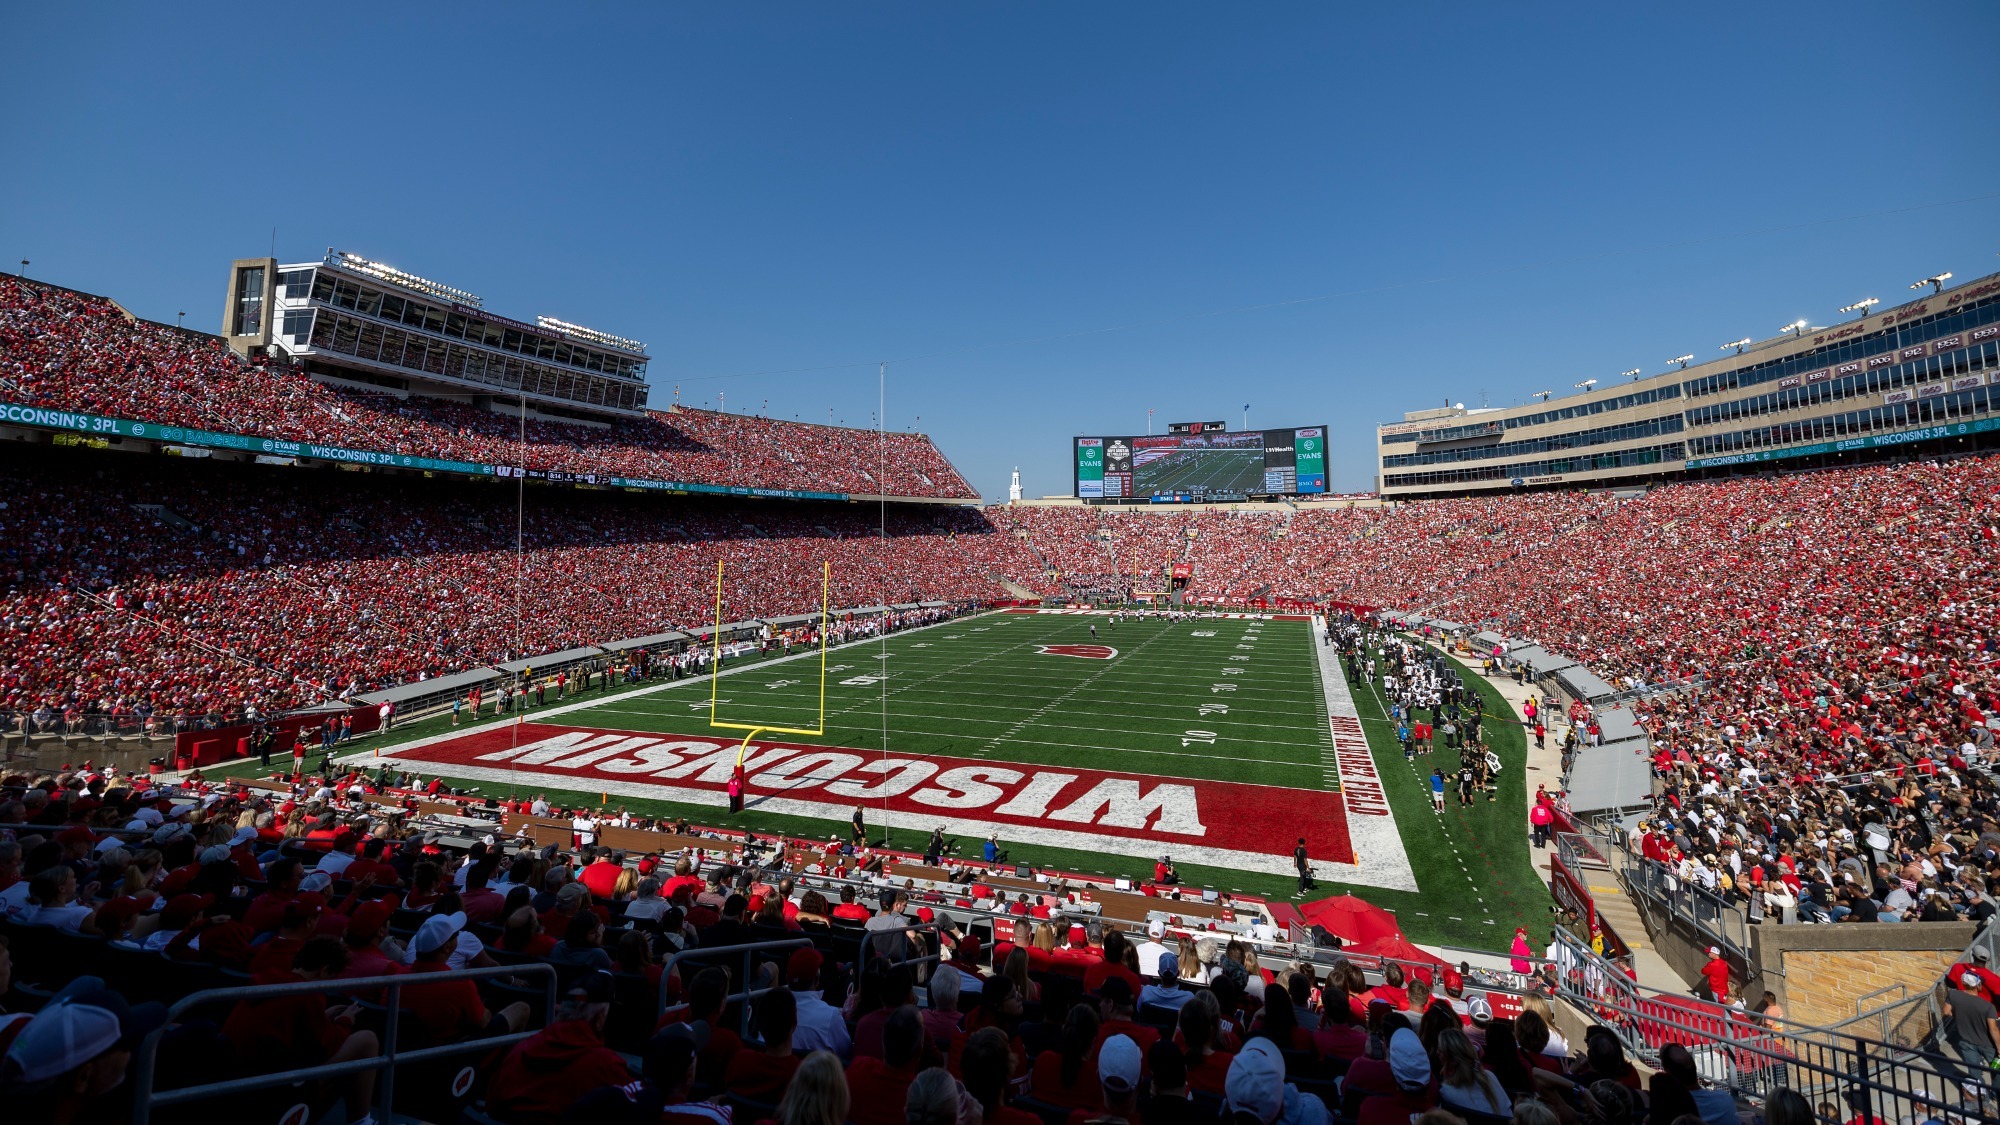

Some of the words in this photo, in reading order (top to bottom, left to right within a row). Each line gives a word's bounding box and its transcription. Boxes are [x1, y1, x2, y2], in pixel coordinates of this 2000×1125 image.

[480, 312, 536, 332] COMMUNICATIONS
[537, 328, 560, 339] CENTER
[1827, 324, 1865, 341] AMECHE
[1974, 327, 1998, 340] 1959
[1937, 337, 1959, 349] 1952
[1904, 347, 1922, 358] 1912
[1840, 364, 1858, 374] 1901
[0, 404, 88, 429] SCONSIN'S
[92, 417, 120, 433] 3PL
[1974, 419, 1992, 431] GO
[160, 427, 184, 439] GO
[186, 430, 249, 449] BADGERS!
[1873, 429, 1931, 445] WISCONSIN'S
[1933, 426, 1951, 437] 3PL
[274, 441, 300, 451] EVANS
[1844, 438, 1865, 447] EVANS
[311, 445, 377, 462] WISCONSIN'S
[379, 453, 396, 465] 3PL
[1297, 451, 1322, 460] EVANS
[1700, 454, 1745, 467] WISCONSIN'S
[1746, 453, 1759, 462] 3PL
[496, 465, 512, 477] W
[625, 479, 663, 489] WISCONSIN'S
[664, 482, 675, 490] 3PL
[753, 488, 784, 497] WISCONSIN'S
[1198, 703, 1230, 716] 20
[1330, 715, 1363, 738] BARRY
[1181, 730, 1218, 747] 10
[1335, 738, 1377, 778] ALVAREZ
[473, 731, 1207, 836] WISCONSIN
[1343, 780, 1389, 816] FIELD
